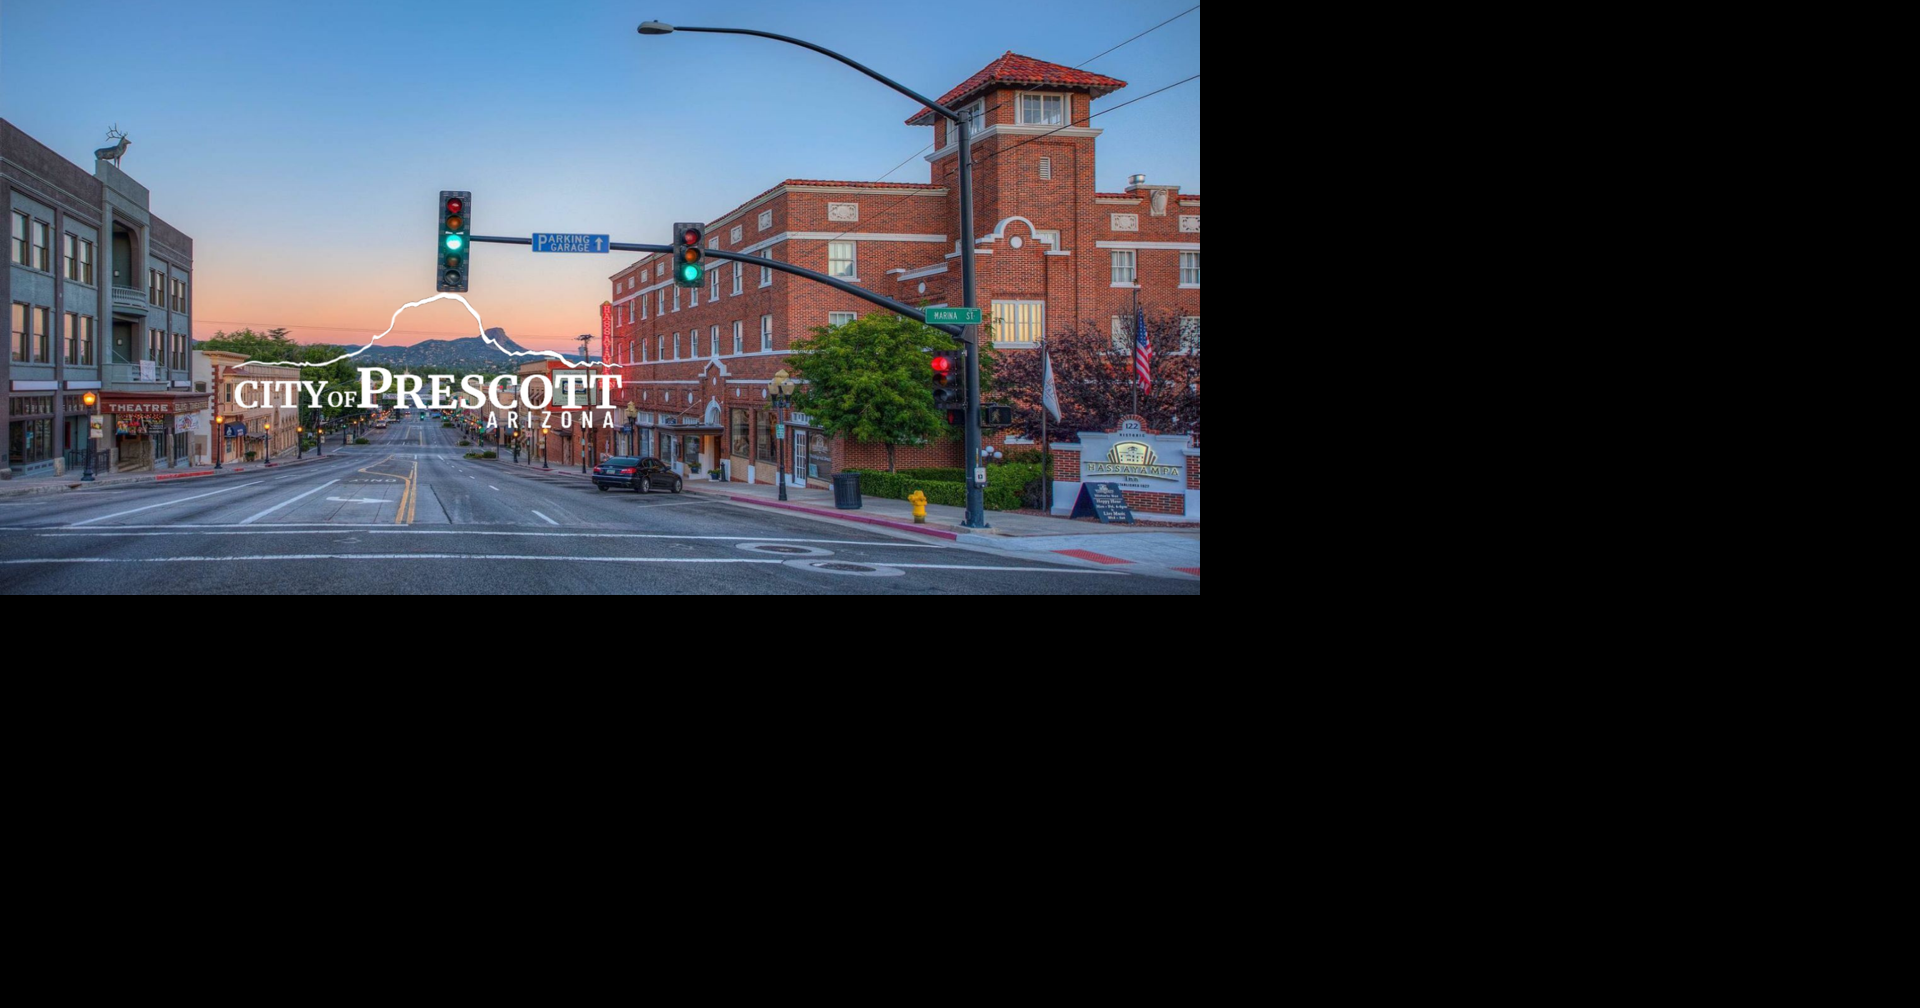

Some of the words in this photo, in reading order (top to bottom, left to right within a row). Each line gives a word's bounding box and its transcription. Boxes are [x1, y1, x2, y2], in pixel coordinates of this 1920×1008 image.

[538, 234, 590, 251] PARKING
[550, 243, 590, 252] GARAGE
[934, 311, 958, 320] MARINA
[602, 305, 612, 376] HASSAYAMP
[109, 403, 169, 412] THEATRE
[1125, 422, 1139, 430] 122
[1088, 463, 1179, 476] HASSAYAMPA
